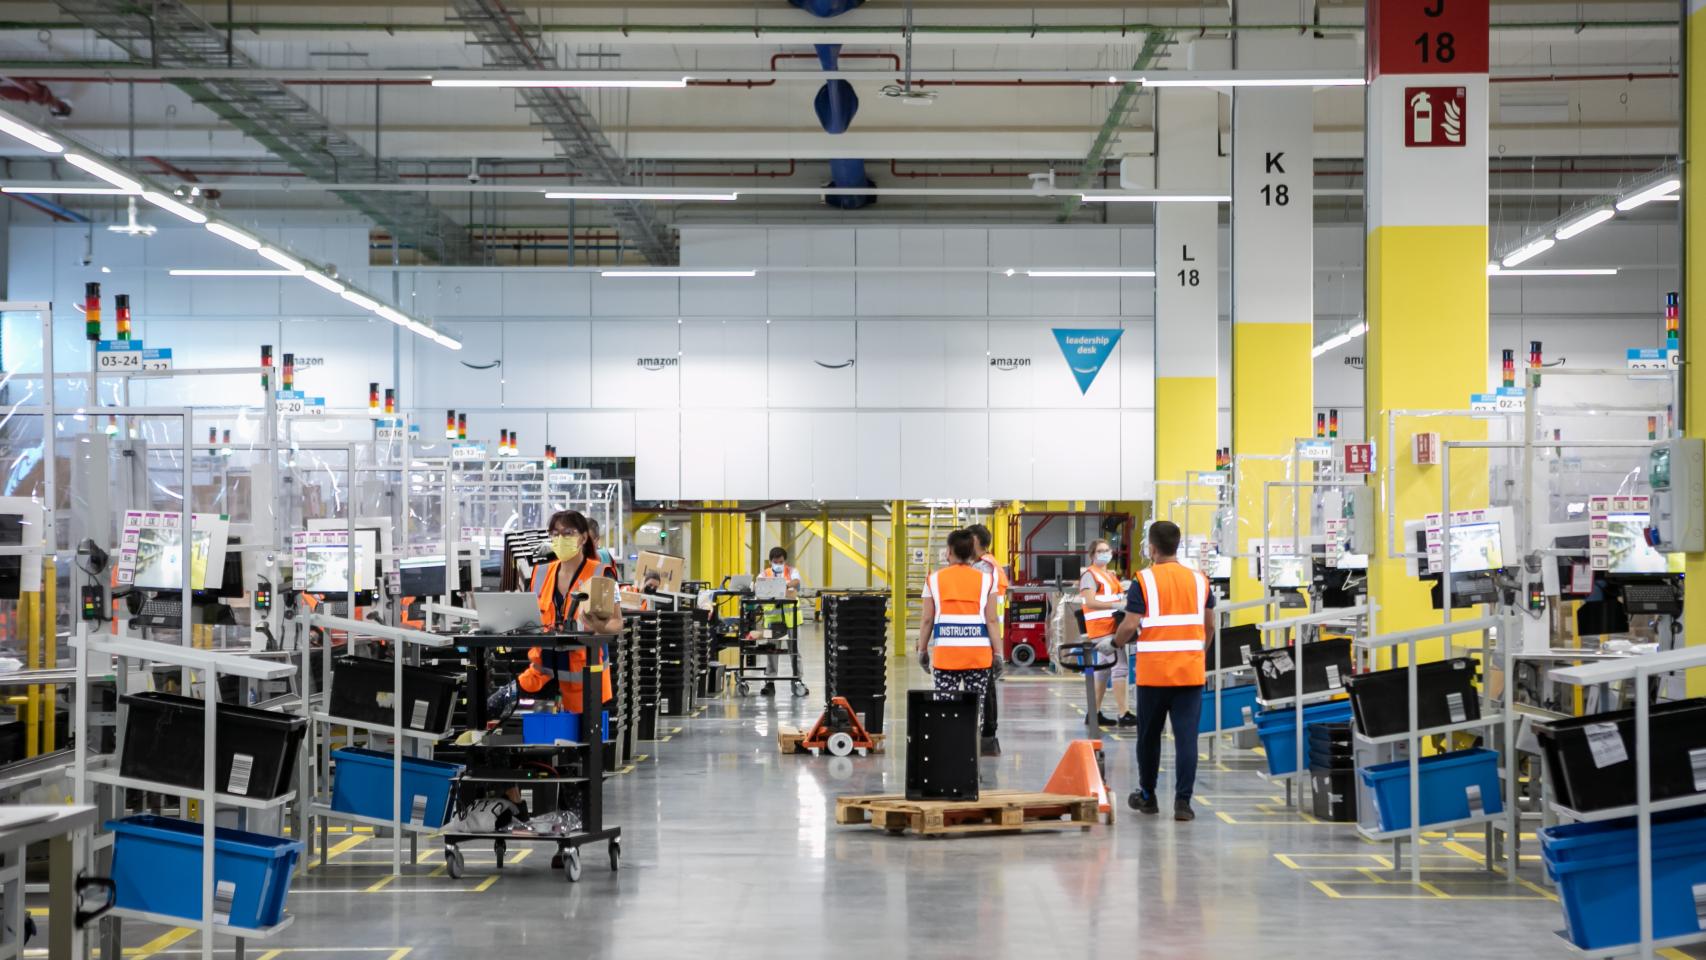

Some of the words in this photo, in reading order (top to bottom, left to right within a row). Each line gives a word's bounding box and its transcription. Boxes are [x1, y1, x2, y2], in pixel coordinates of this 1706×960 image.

[1413, 31, 1456, 64] 18
[1265, 151, 1286, 174] K
[1260, 183, 1289, 206] 18
[1182, 244, 1195, 262] L
[1177, 269, 1200, 287] 18
[1066, 336, 1109, 346] leadership
[1077, 346, 1097, 354] desk
[101, 356, 138, 366] 03-24
[637, 358, 678, 366] amazon
[990, 358, 1031, 366] amazon
[1344, 356, 1364, 365] am
[939, 626, 982, 636] INSTRUCTOR
